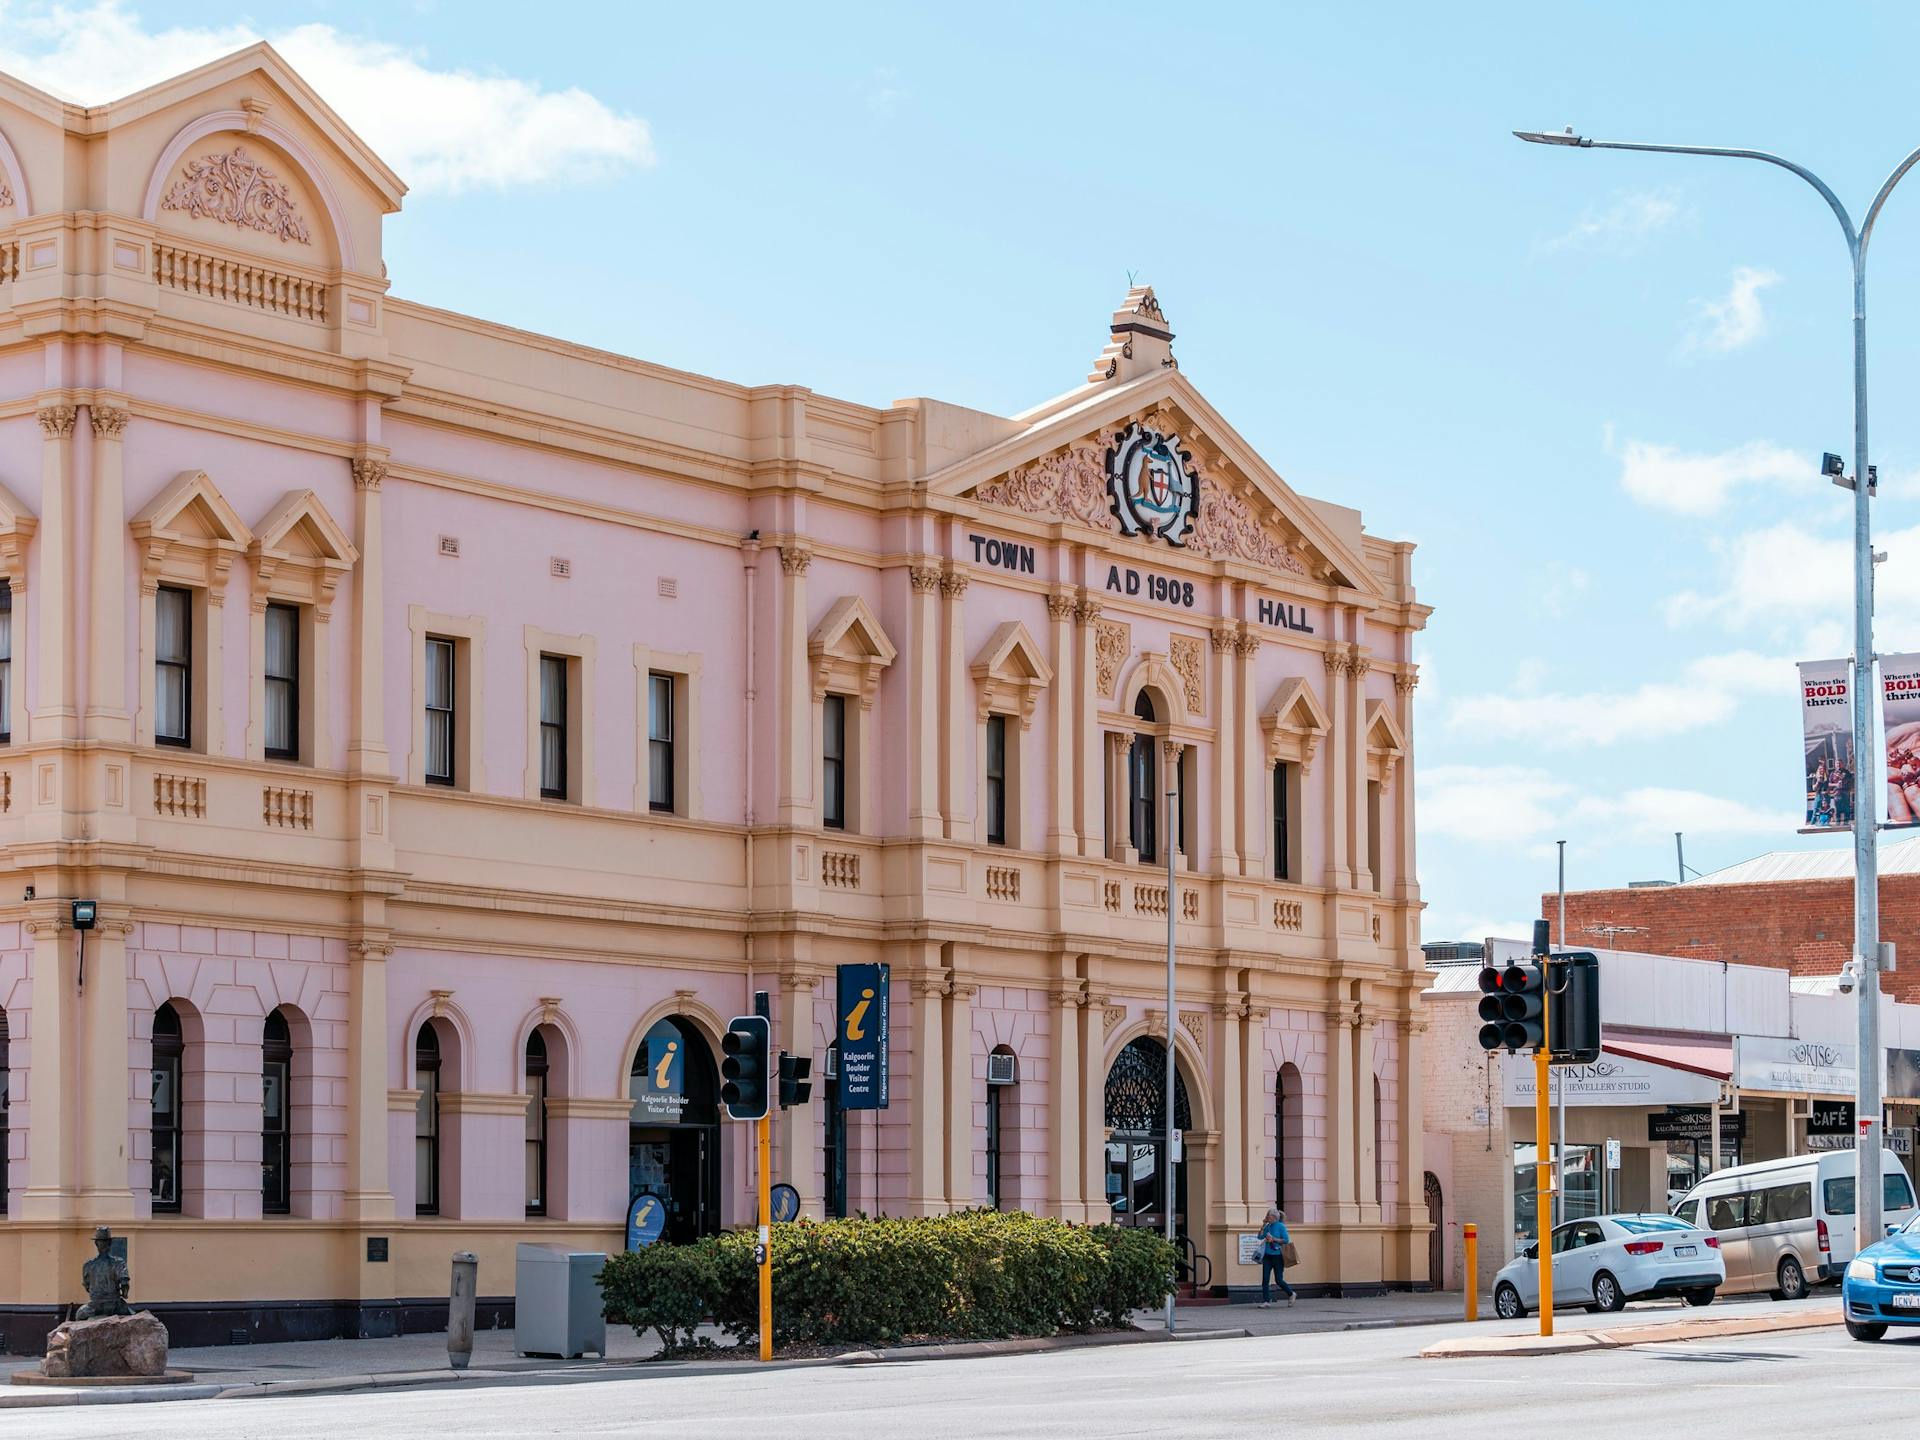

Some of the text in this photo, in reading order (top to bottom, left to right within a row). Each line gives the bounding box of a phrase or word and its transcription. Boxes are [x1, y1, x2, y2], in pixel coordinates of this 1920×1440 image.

[969, 534, 1035, 574] TOWN
[1148, 574, 1195, 608] 1908
[1258, 598, 1314, 634] HALL
[1805, 685, 1847, 698] BOLD
[1886, 691, 1920, 701] thriv
[1806, 697, 1848, 707] thrive.
[843, 1052, 875, 1063] Kalgoorlie
[846, 1063, 871, 1072] Boulder
[848, 1074, 870, 1082] Visitor
[848, 1085, 870, 1093] Centre
[1569, 1083, 1617, 1092] JEWELLERY
[1617, 1082, 1651, 1091] STUDIO
[641, 1095, 690, 1105] Kalgoorlie Boulder
[647, 1105, 683, 1114] Visitor Centre
[1812, 1105, 1848, 1126] CAFÉ
